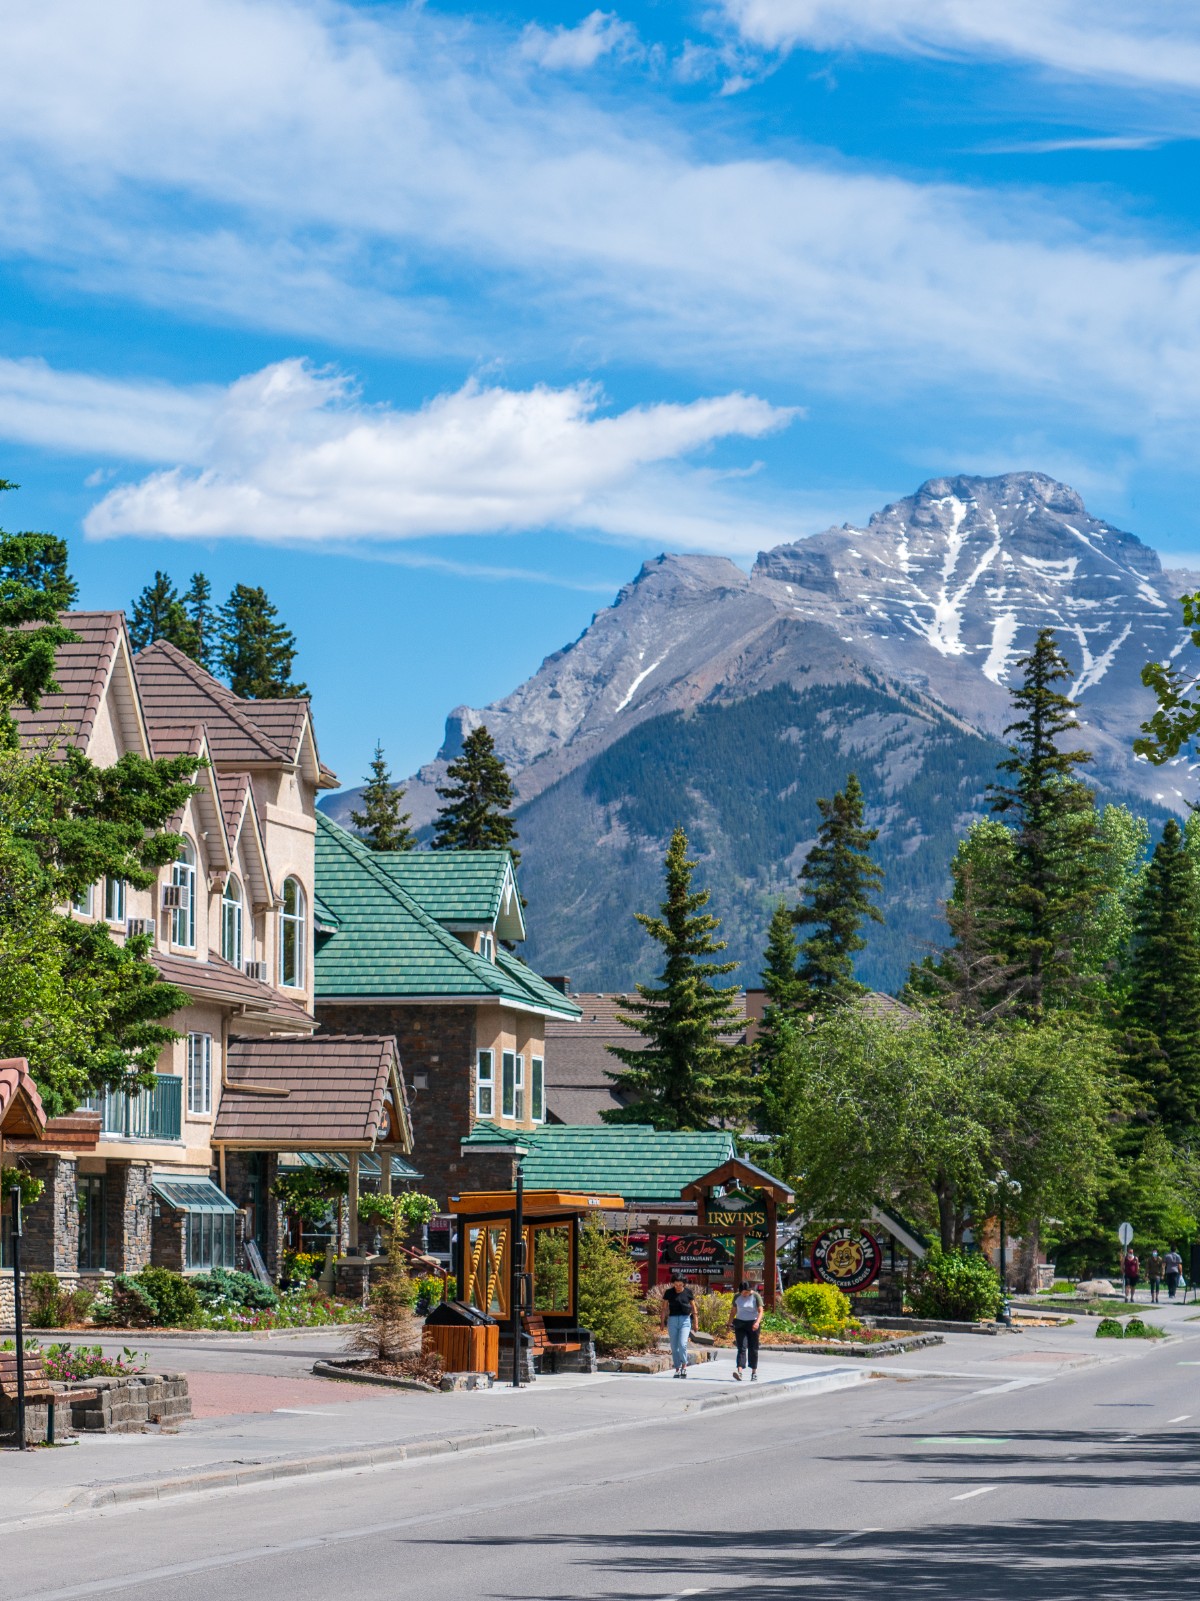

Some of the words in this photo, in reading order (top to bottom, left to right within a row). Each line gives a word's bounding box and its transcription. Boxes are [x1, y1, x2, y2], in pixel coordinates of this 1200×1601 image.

[707, 1211, 765, 1227] IRWIN'S
[674, 1240, 693, 1254] El
[693, 1239, 717, 1255] Toro
[815, 1228, 874, 1258] SAMEUN
[852, 1267, 871, 1285] LODGES
